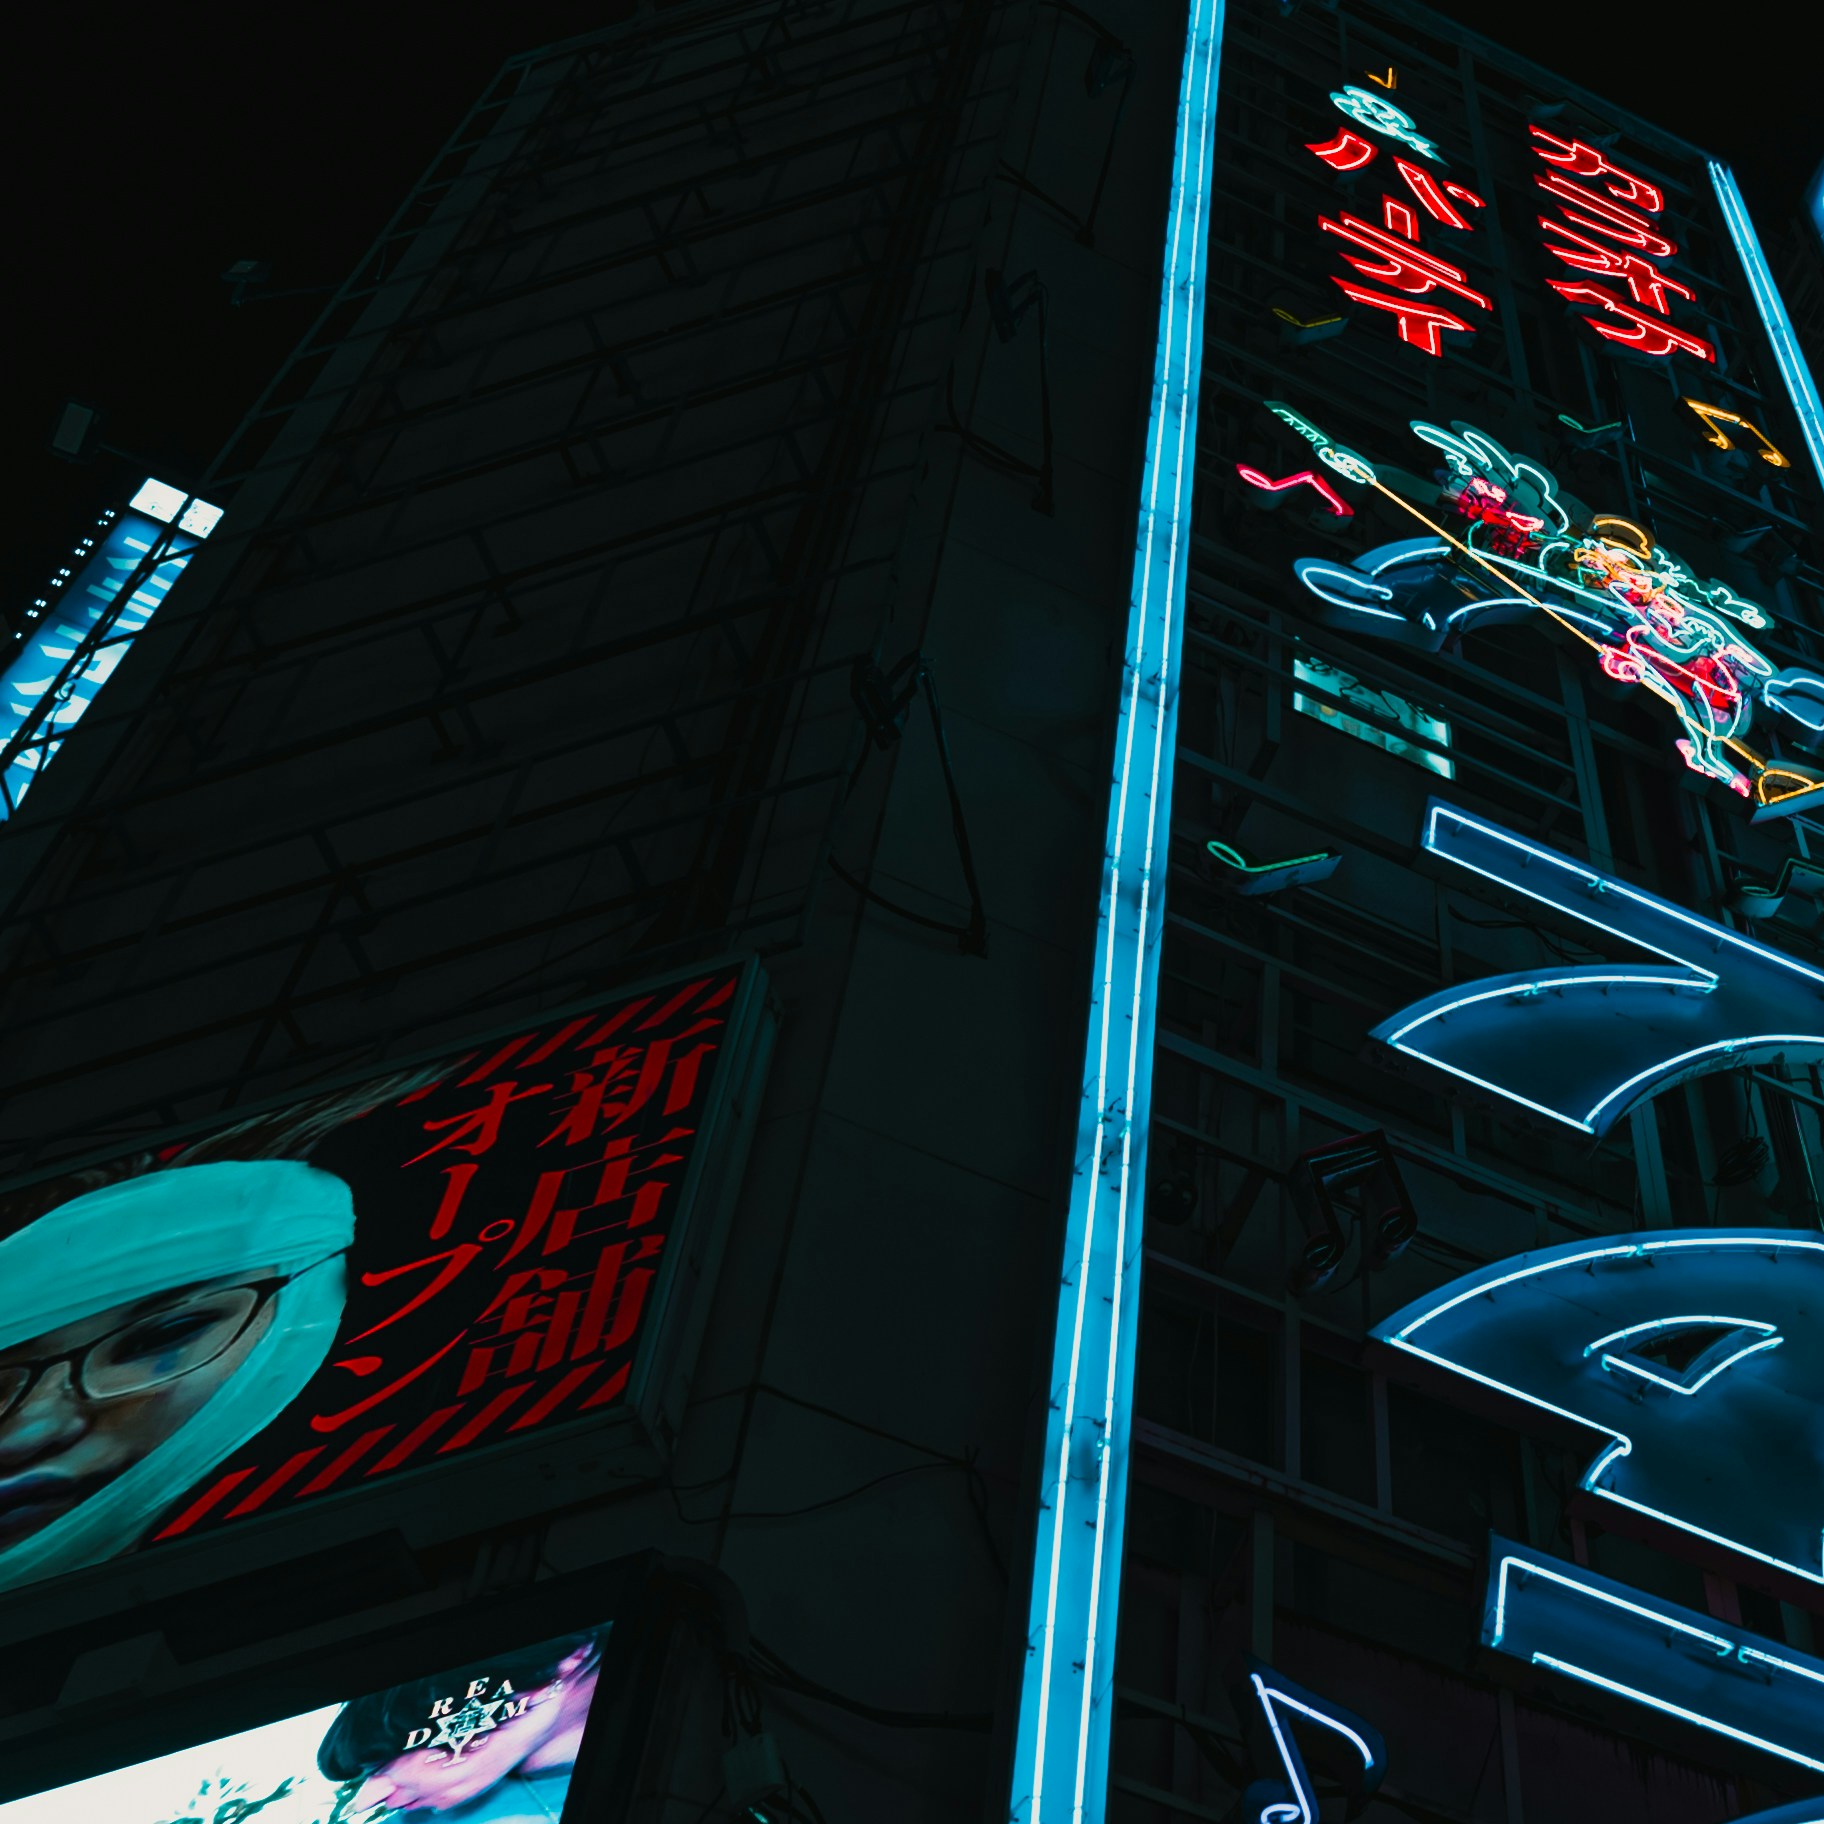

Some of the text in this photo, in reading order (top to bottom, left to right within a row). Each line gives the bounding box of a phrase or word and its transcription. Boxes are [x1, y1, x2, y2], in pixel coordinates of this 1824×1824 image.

[1528, 122, 1717, 363] カラオケ
[309, 1080, 556, 1433] オープン
[456, 1018, 723, 1399] 新店舗
[403, 1677, 531, 1750] DREAM
